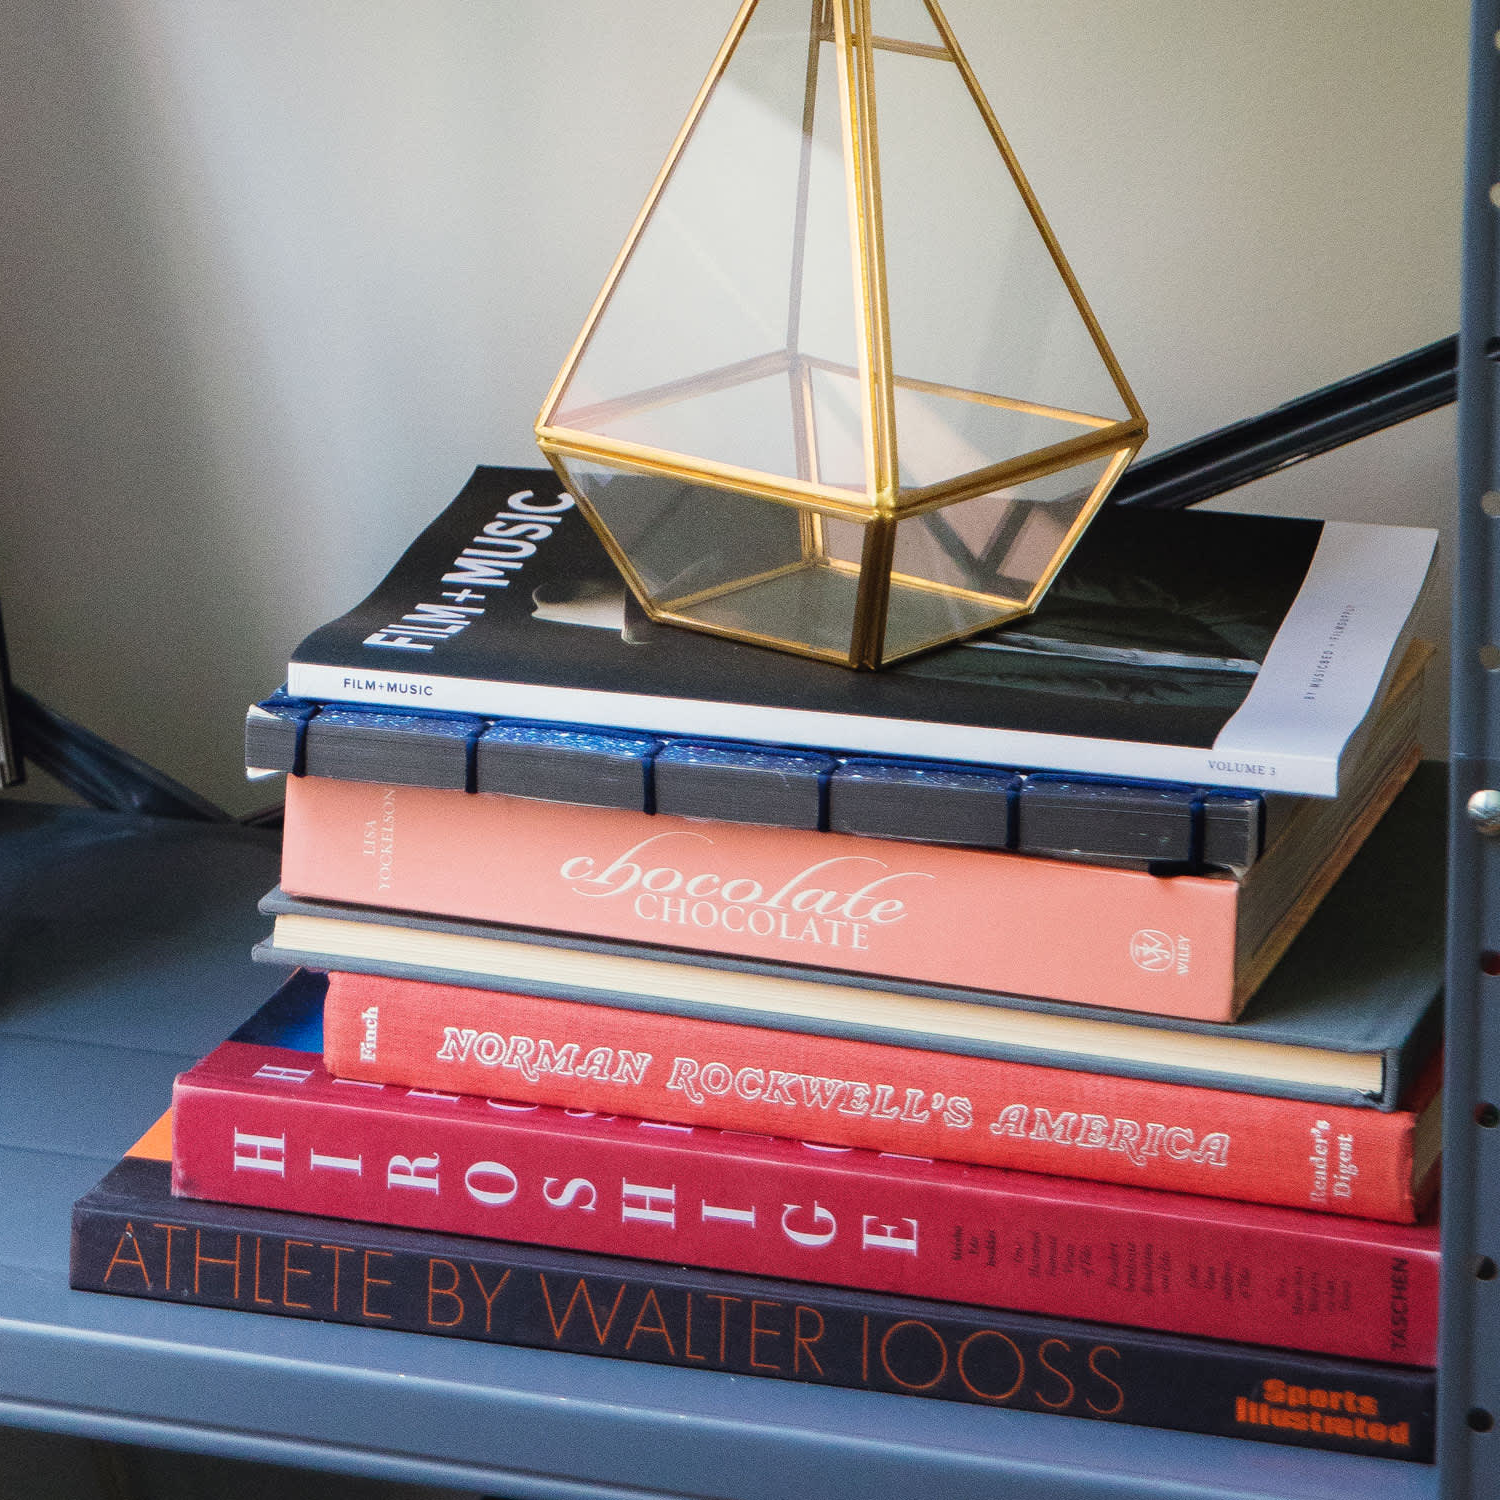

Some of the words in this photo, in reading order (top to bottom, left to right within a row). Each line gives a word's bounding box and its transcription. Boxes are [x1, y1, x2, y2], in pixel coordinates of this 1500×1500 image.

[362, 489, 578, 653] FILM+MUSIC
[342, 676, 435, 698] FILM+MUSIC
[1208, 758, 1266, 776] VOLUME
[1267, 764, 1277, 776] 3
[364, 819, 378, 858] LISA
[380, 789, 398, 891] YOCKELSON
[560, 831, 935, 926] chocolate
[635, 892, 870, 950] CHOCOLATE
[1176, 935, 1190, 976] WILEY
[360, 1005, 379, 1063] Finch
[438, 1026, 653, 1084] NORMAN
[668, 1056, 973, 1130] ROCKWELL'S
[991, 1103, 1231, 1167] AMERICA
[233, 1125, 920, 1257] HIROSHIGE
[1309, 1119, 1331, 1204] Reader's
[1332, 1133, 1359, 1200] Digest
[103, 1222, 394, 1321] ATHLETE
[427, 1257, 511, 1333] BY
[540, 1272, 827, 1378] WALTER
[860, 1314, 1125, 1415] IOOSS
[1388, 1257, 1410, 1356] TASCHEN
[1235, 1395, 1411, 1447] Illustrated
[1264, 1377, 1380, 1416] Sports
